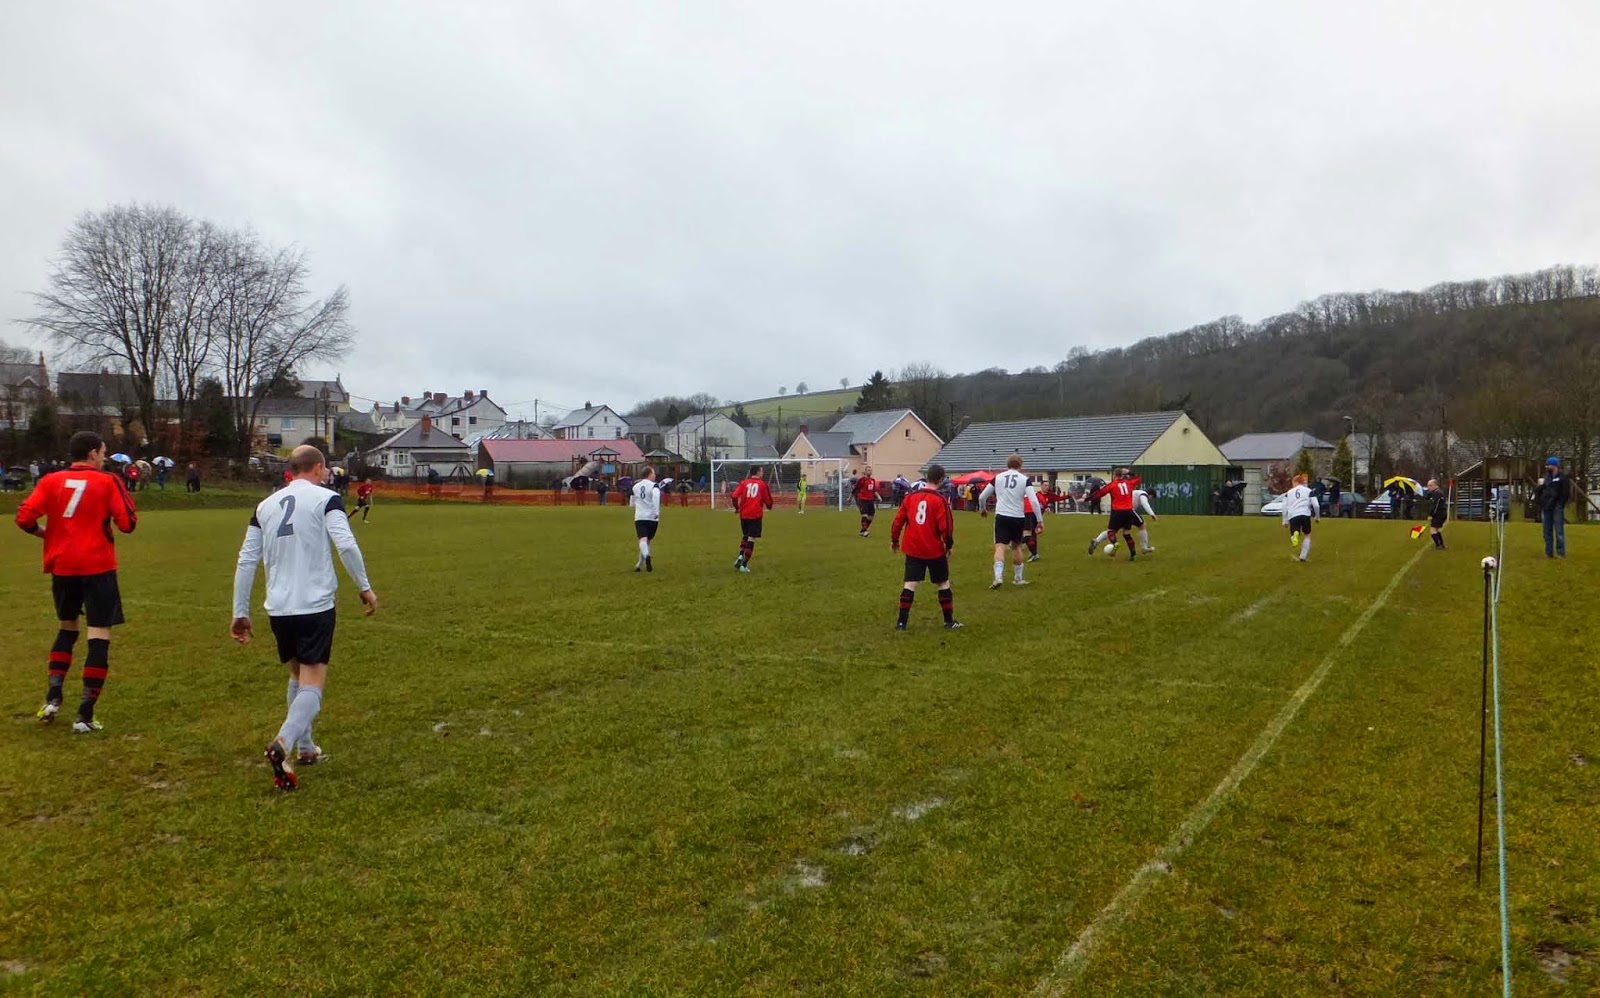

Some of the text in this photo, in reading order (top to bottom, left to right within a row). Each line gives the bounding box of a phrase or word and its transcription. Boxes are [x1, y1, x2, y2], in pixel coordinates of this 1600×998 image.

[1004, 474, 1018, 489] 15
[1117, 481, 1129, 496] 11
[64, 479, 87, 518] 7
[640, 485, 646, 500] 8
[746, 482, 759, 499] 10
[1295, 488, 1301, 500] 6
[277, 495, 295, 538] 2
[915, 500, 927, 525] 8
